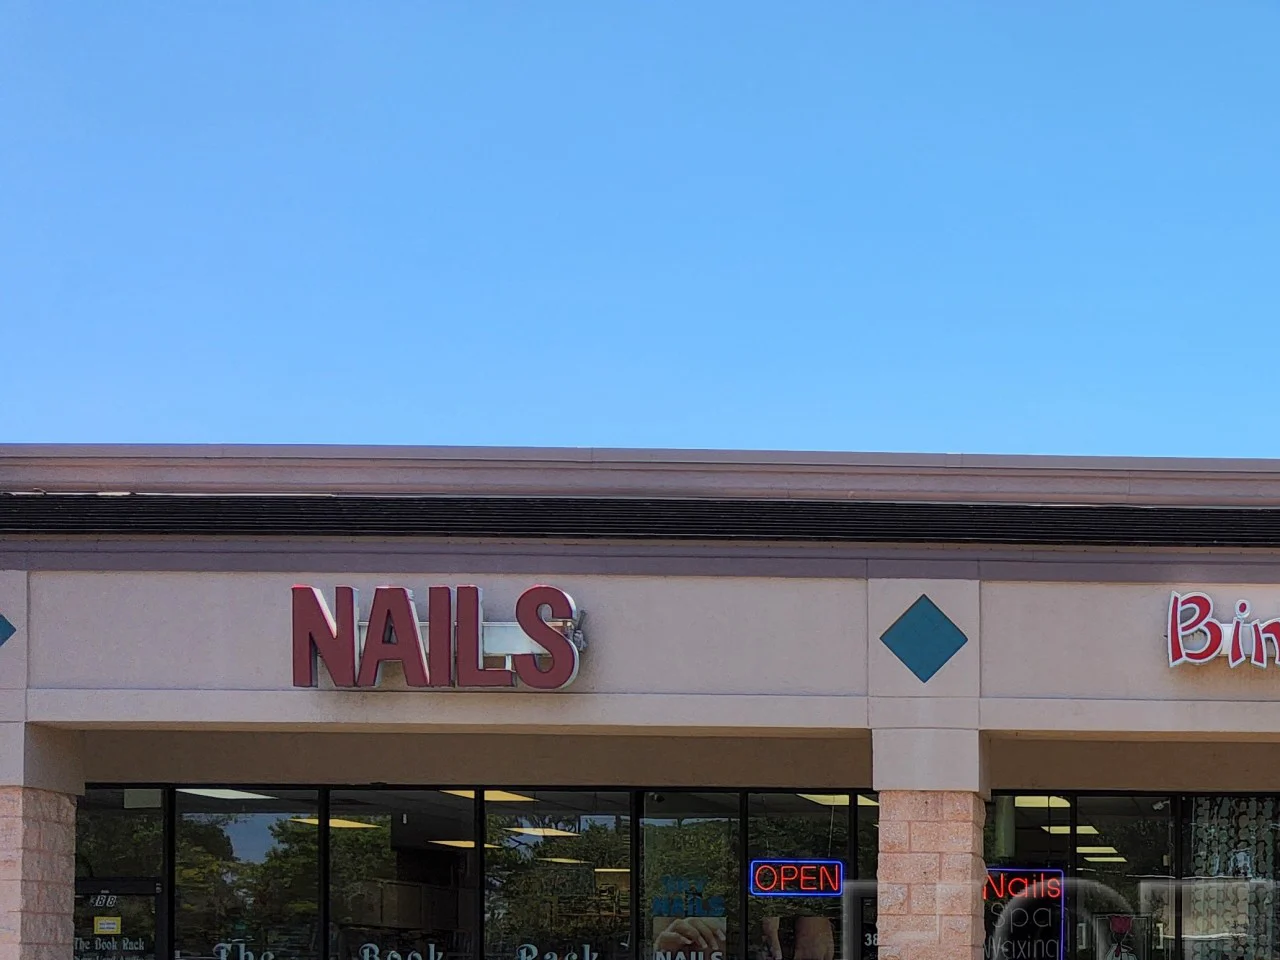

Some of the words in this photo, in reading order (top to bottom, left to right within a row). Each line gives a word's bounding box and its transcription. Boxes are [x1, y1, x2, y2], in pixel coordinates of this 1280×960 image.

[292, 585, 577, 688] NAILS
[755, 864, 839, 891] OPEN
[983, 873, 1061, 900] Nails
[990, 902, 1052, 933] Spa
